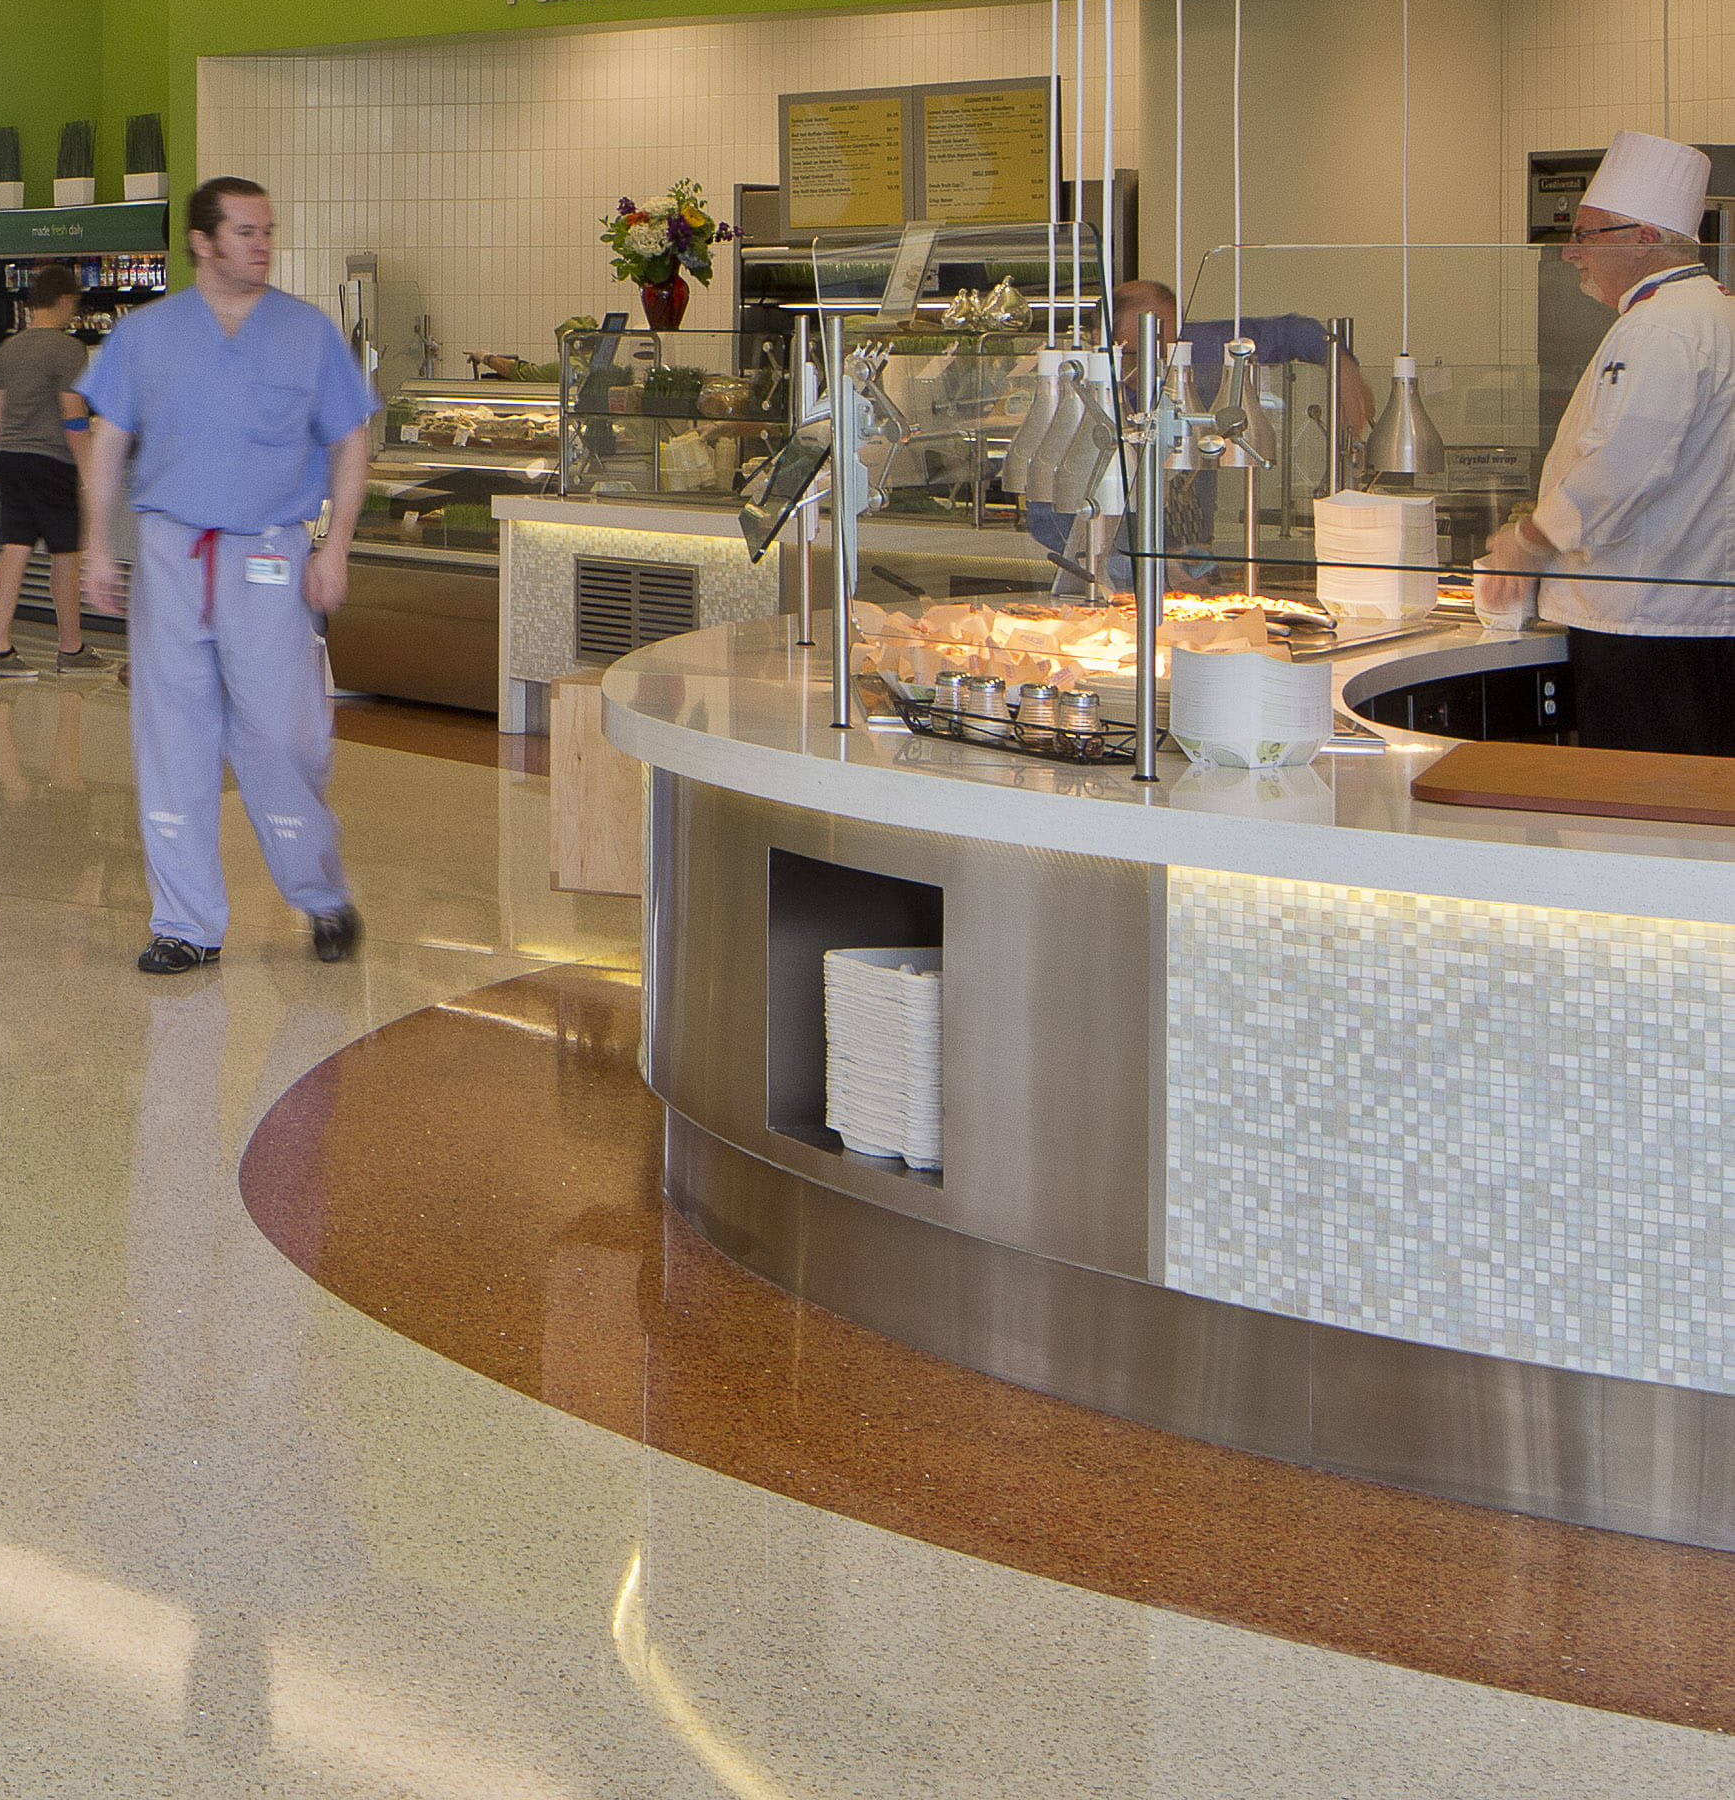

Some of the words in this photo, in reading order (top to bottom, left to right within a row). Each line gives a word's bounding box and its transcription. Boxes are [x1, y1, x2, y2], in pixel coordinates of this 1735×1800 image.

[32, 225, 50, 237] made
[51, 224, 67, 236] fresh
[69, 223, 83, 238] daily
[1459, 454, 1490, 465] crystal
[1492, 456, 1517, 465] wrap
